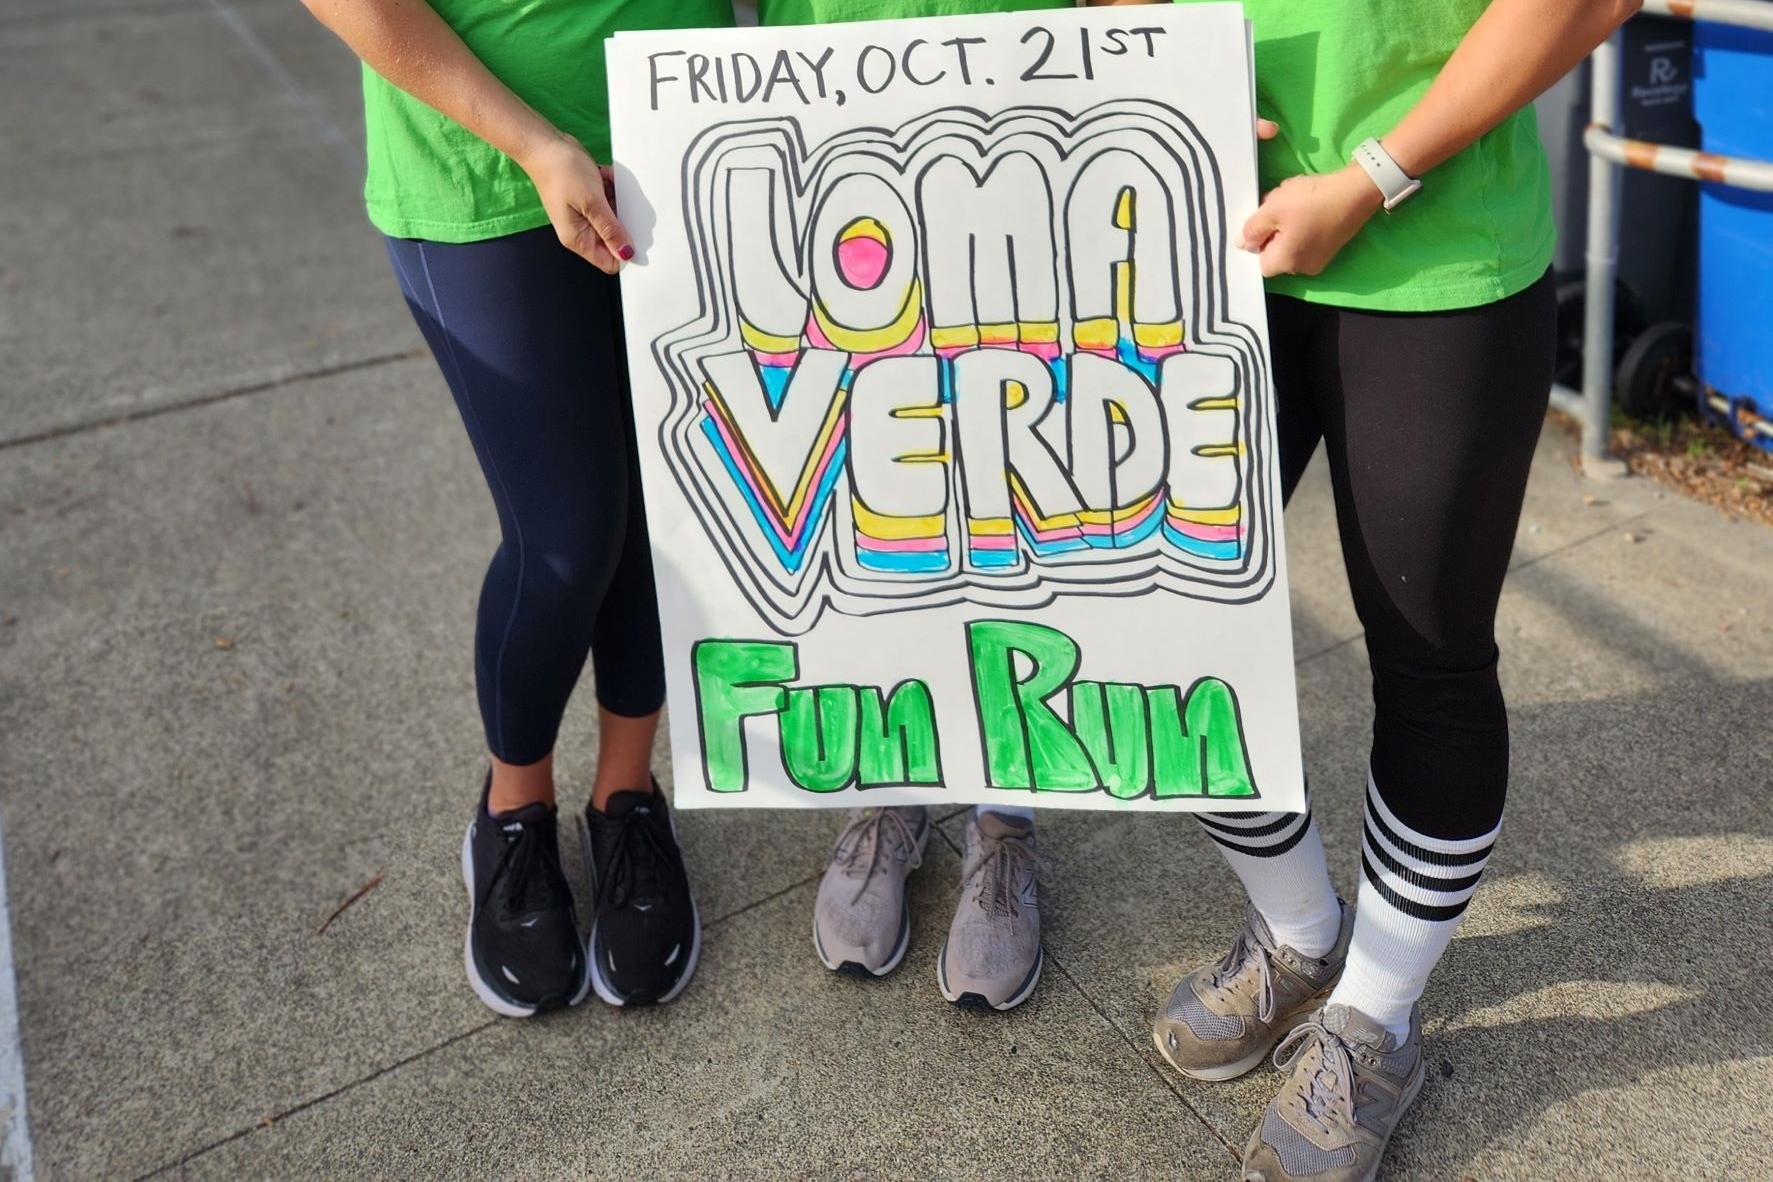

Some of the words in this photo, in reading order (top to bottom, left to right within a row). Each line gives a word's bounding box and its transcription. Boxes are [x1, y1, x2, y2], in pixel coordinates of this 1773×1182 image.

[647, 46, 847, 111] FRIDAY,
[855, 35, 996, 95] OCT.
[725, 147, 1187, 343] LOMA
[698, 347, 1243, 553] VERDE
